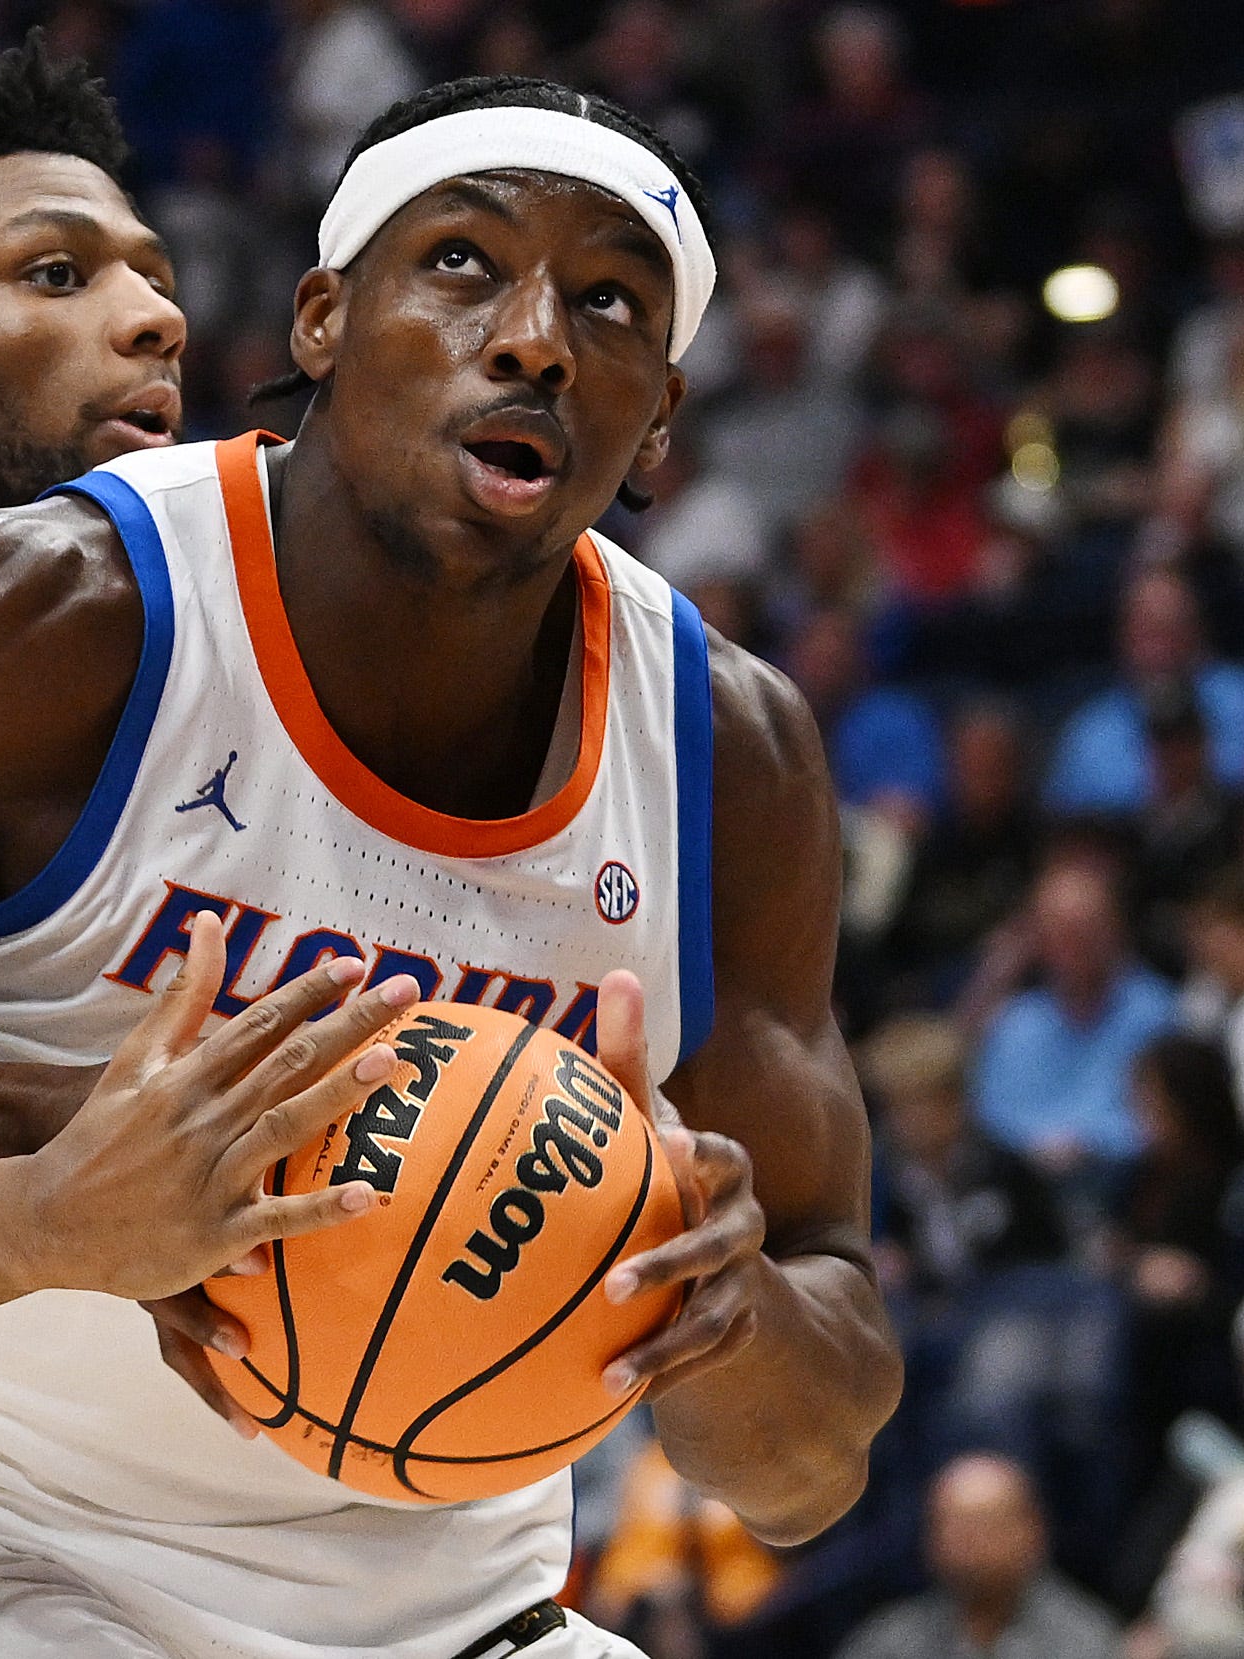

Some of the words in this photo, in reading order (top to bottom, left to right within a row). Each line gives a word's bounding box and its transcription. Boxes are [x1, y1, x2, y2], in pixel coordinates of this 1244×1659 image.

[599, 865, 636, 919] SEC
[312, 1122, 338, 1182] BALL
[440, 1048, 624, 1301] Wilson
[475, 1159, 500, 1192] BALL
